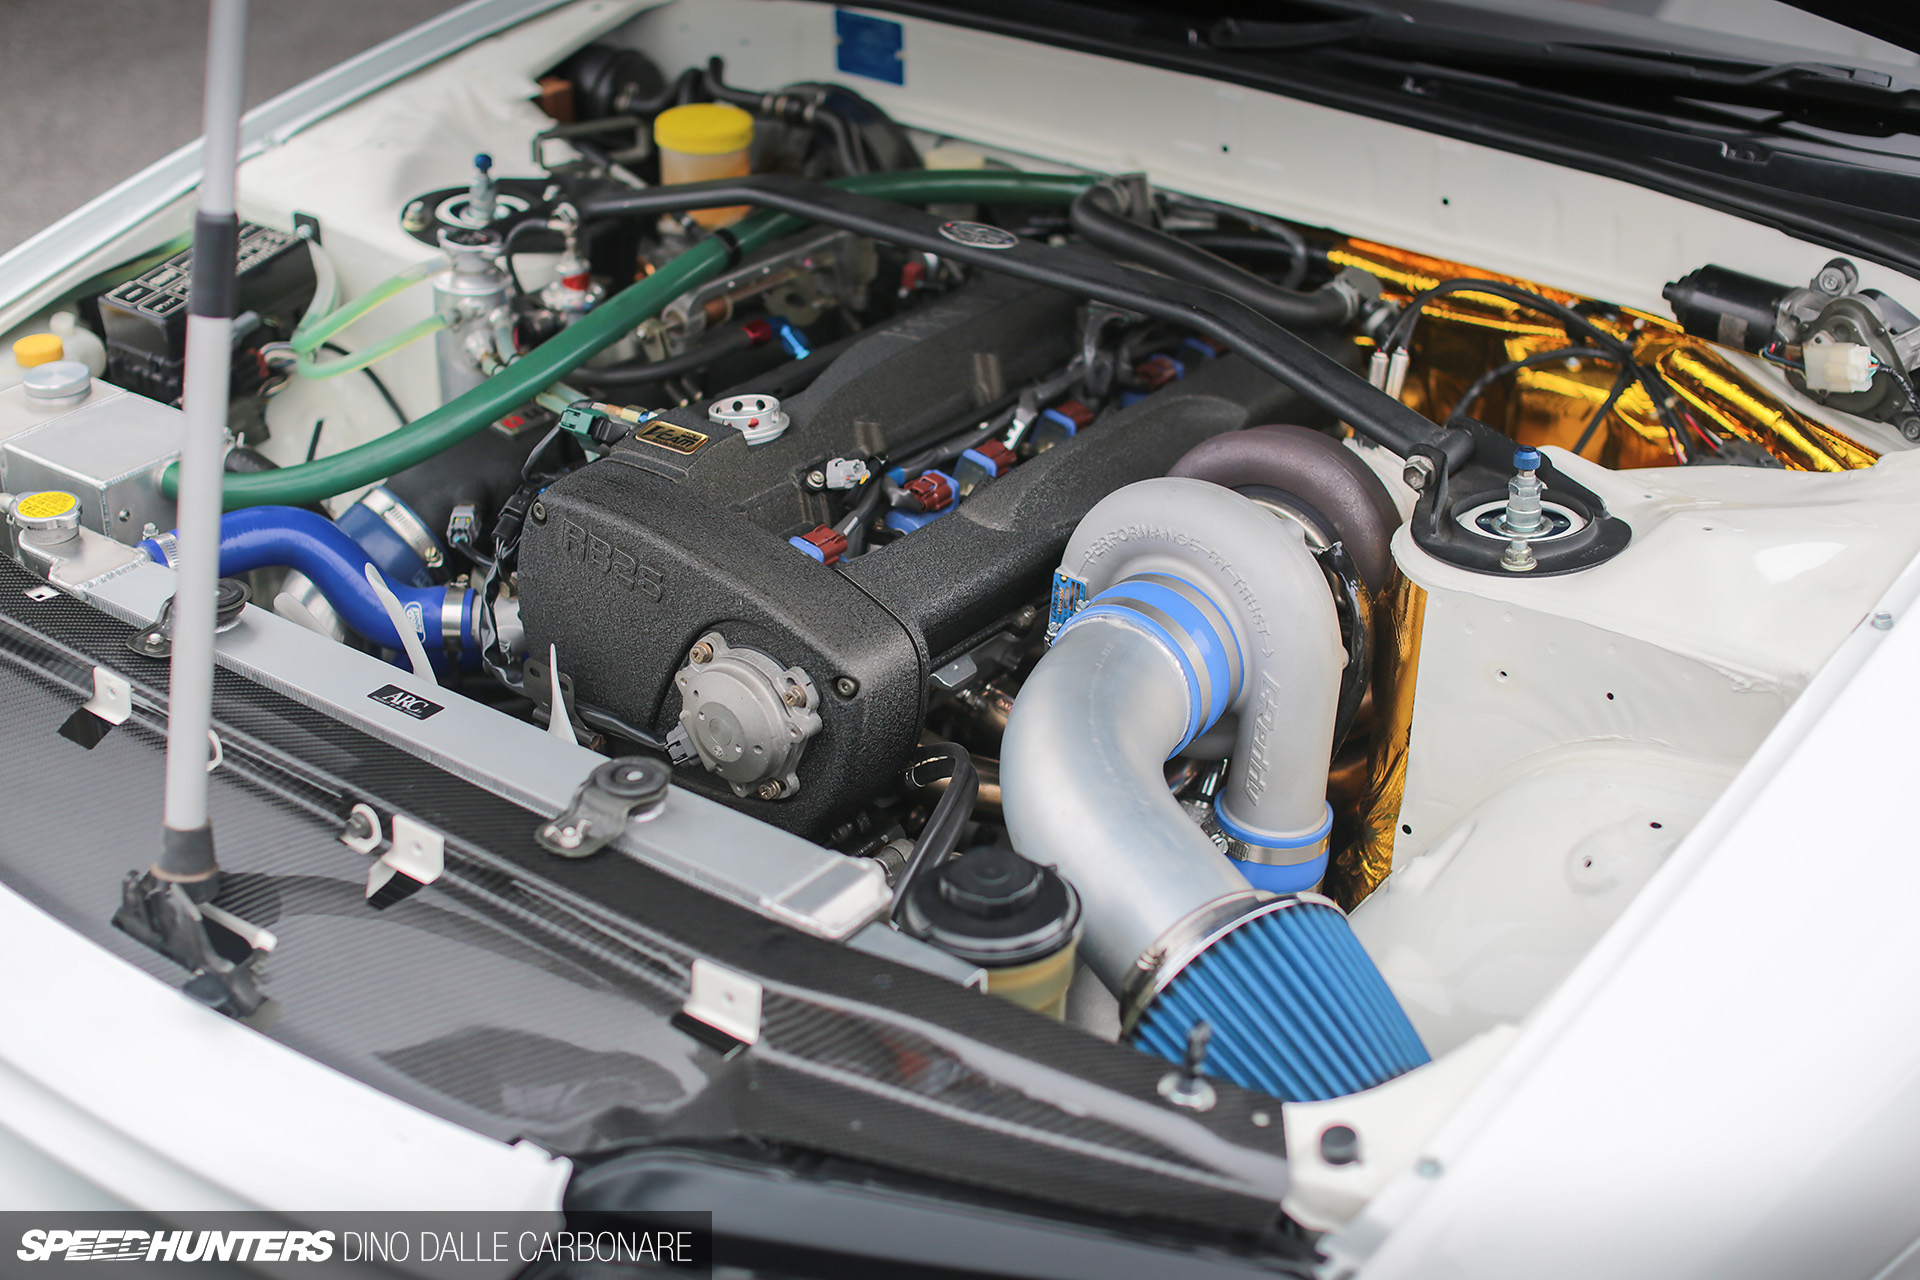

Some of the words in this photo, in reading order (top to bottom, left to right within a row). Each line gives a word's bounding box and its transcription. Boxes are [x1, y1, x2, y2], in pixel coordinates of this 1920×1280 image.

[1084, 524, 1201, 564] PERFORMANCE
[1209, 551, 1232, 571] BY
[1234, 574, 1272, 637] TRUST
[382, 692, 429, 712] ARC
